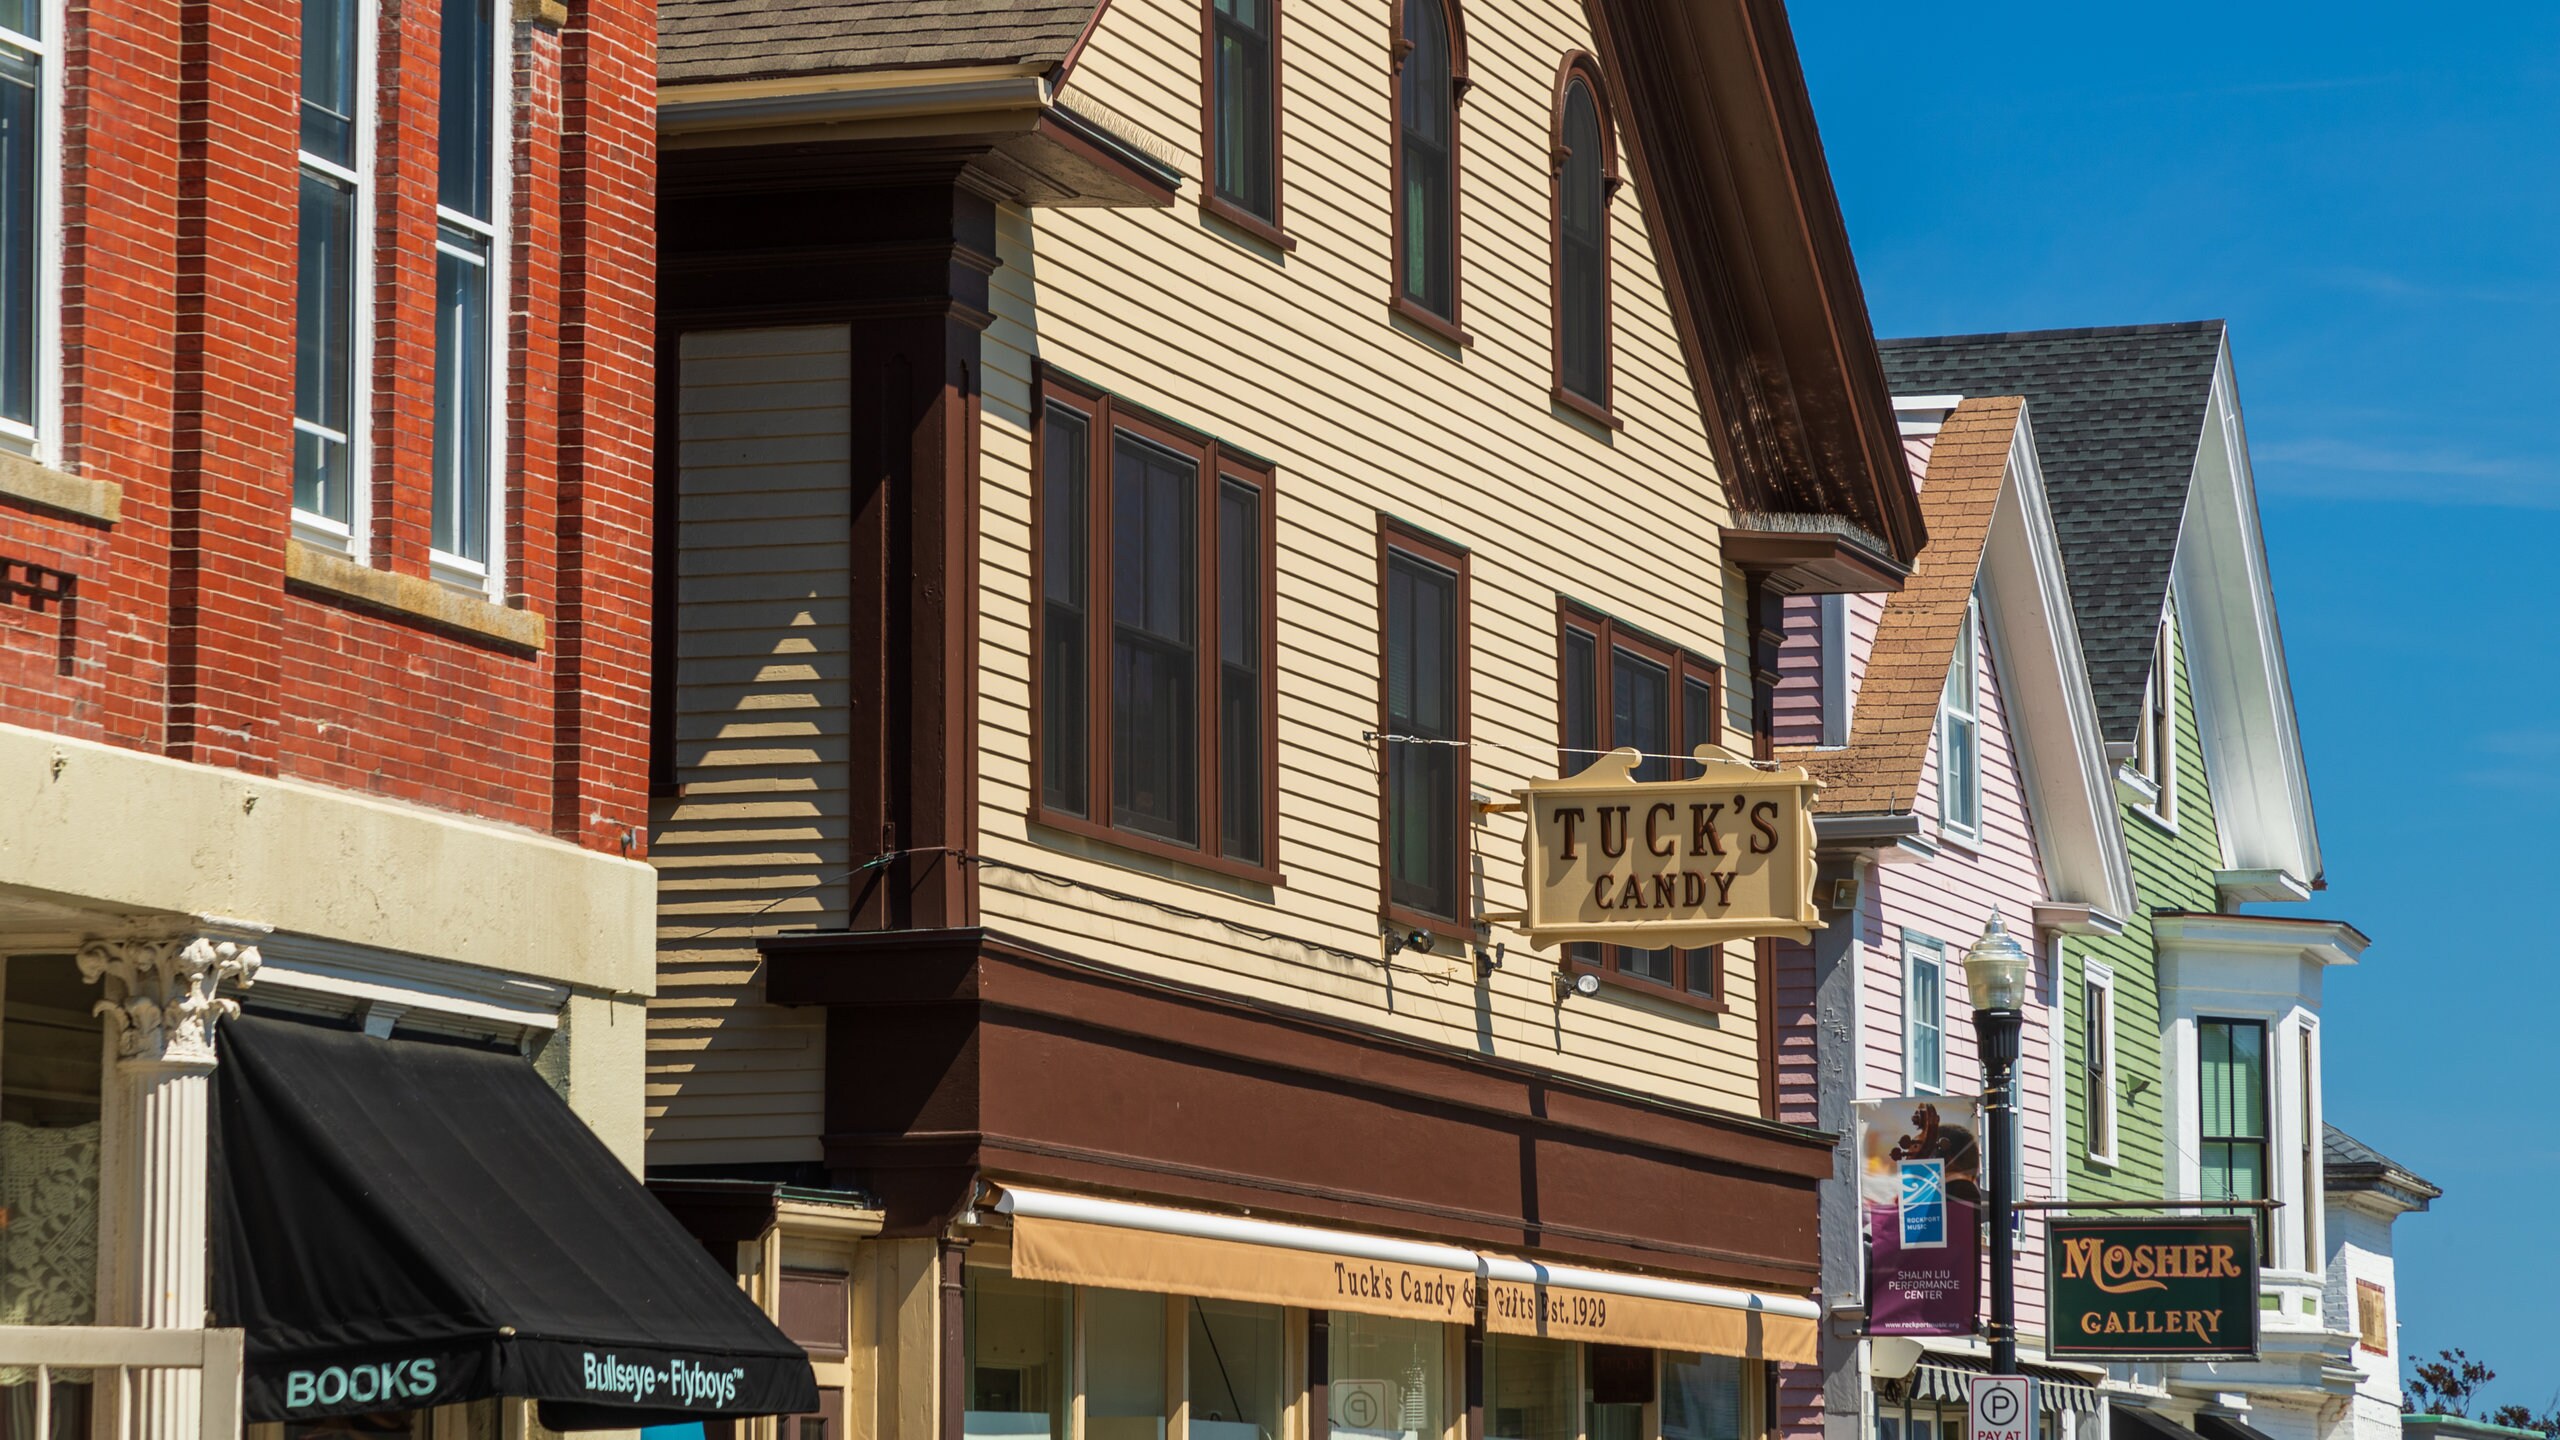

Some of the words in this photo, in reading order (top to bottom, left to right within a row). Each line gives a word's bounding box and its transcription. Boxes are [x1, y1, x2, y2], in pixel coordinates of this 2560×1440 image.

[1553, 794, 1779, 860] TUCK'S
[1594, 870, 1738, 910] CANDY
[1906, 1215, 1941, 1224] ROCKPORT
[1897, 1270, 1932, 1280] SHALIN
[1934, 1270, 1950, 1280] LIU
[2061, 1237, 2242, 1294] MOSHER
[1334, 1260, 1393, 1299] Tuck's
[1400, 1270, 1455, 1316] Candy
[1462, 1278, 1475, 1309] &
[1494, 1285, 1534, 1320] Gifts
[1888, 1280, 1960, 1290] PERFORMANCE
[1904, 1290, 1943, 1300] CENTER
[1884, 1321, 1960, 1330] www.rockportmusic.org
[2081, 1309, 2223, 1344] GALLERY
[286, 1358, 438, 1408] BOOKS
[1992, 1395, 2010, 1419] P
[1977, 1430, 2002, 1440] PAY
[2005, 1430, 2021, 1440] AT
